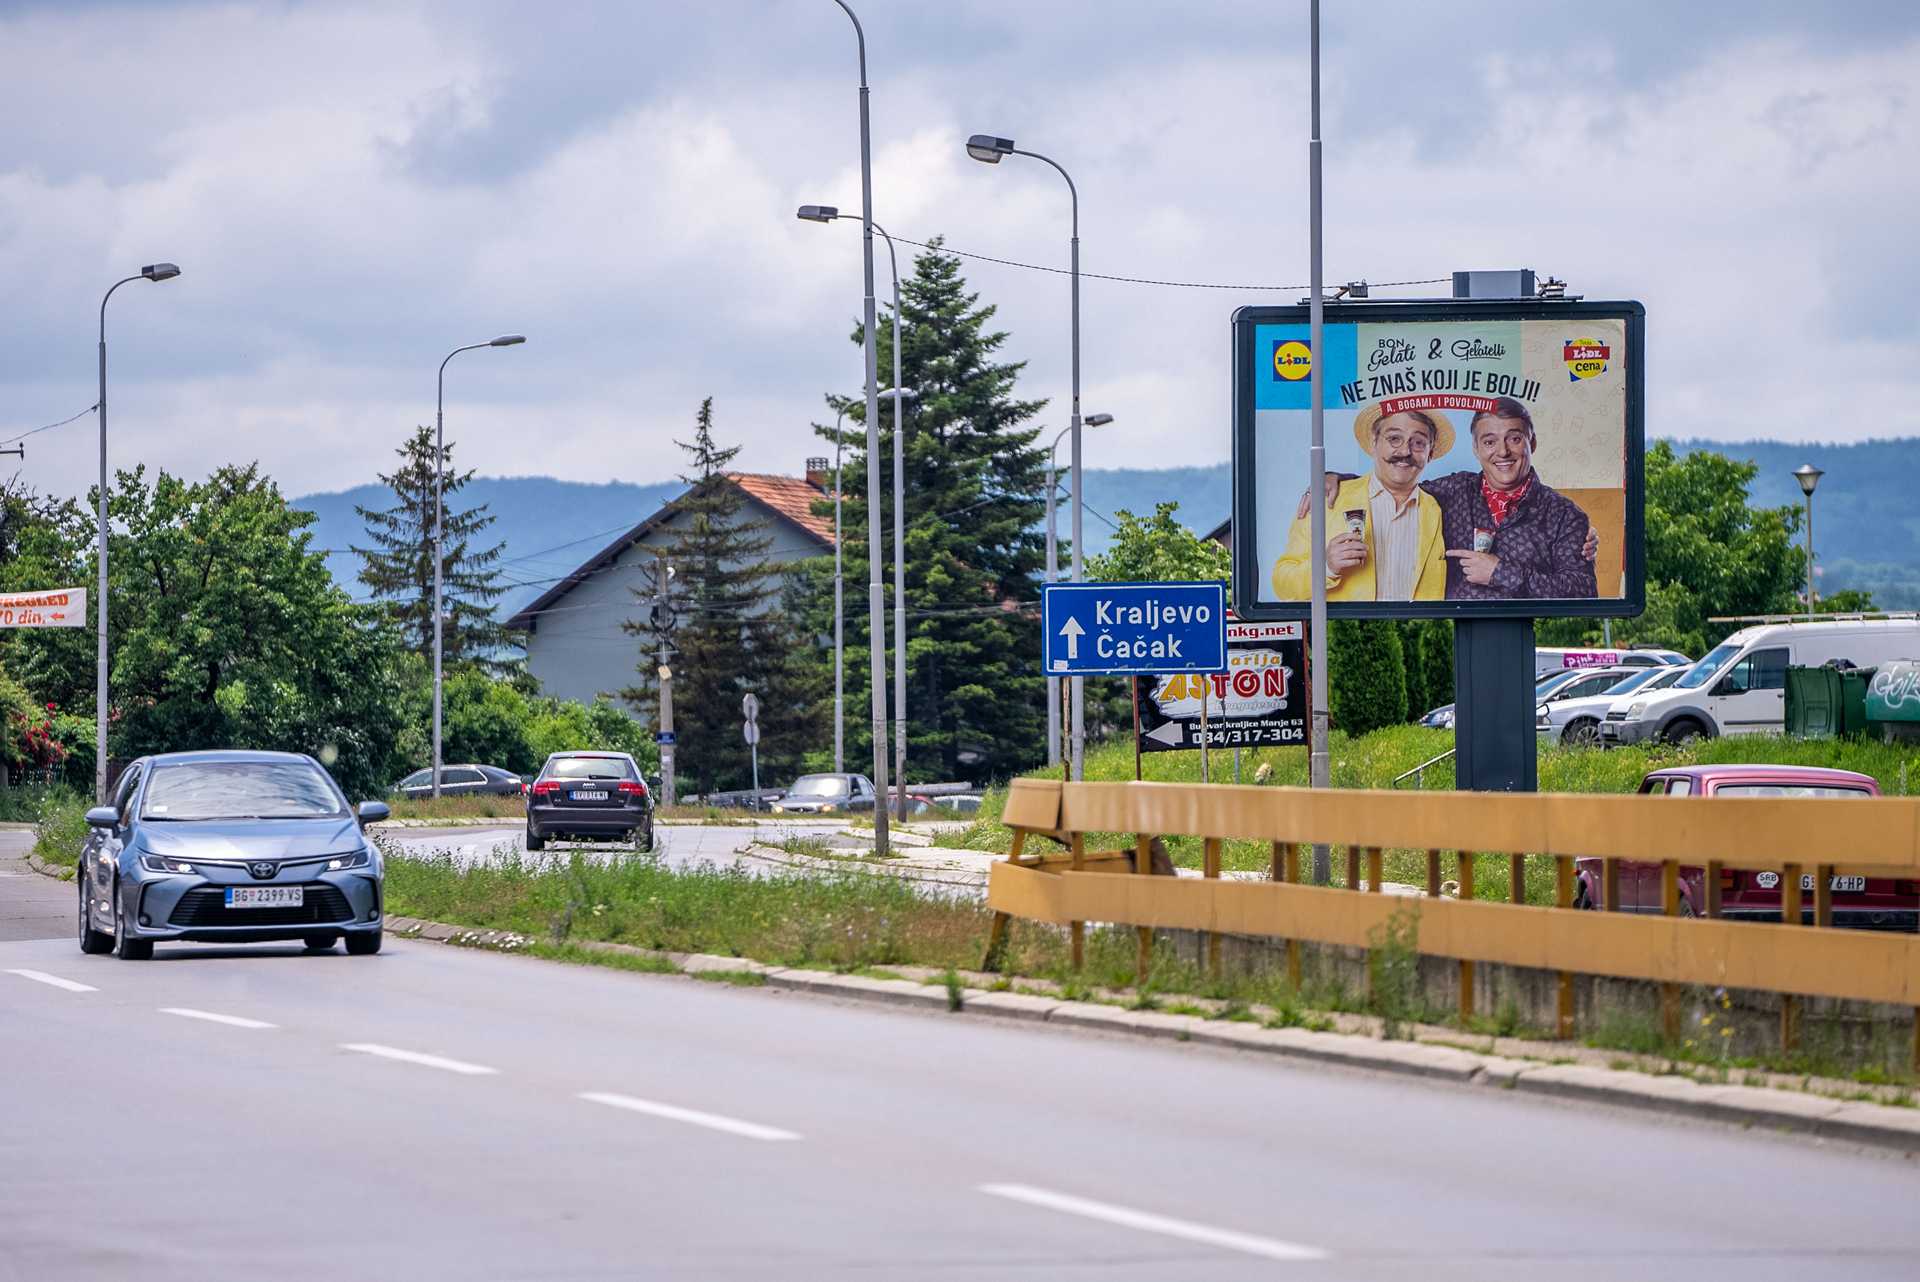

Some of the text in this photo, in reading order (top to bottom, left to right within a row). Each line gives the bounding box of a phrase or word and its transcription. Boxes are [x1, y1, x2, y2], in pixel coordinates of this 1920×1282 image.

[1378, 338, 1405, 349] BON
[1367, 344, 1416, 372] Gelati
[1428, 337, 1443, 360] &
[1575, 362, 1601, 372] cena
[1340, 367, 1541, 405] NE ZNAŠ KOJI JE BOLJI!
[1444, 398, 1493, 411] POVOLJNIJI
[1096, 600, 1210, 630] Kraljevo
[1097, 628, 1183, 658] Čačak
[1225, 721, 1258, 730] kraljice
[1192, 728, 1304, 744] 034/317-304
[234, 889, 248, 902] BG
